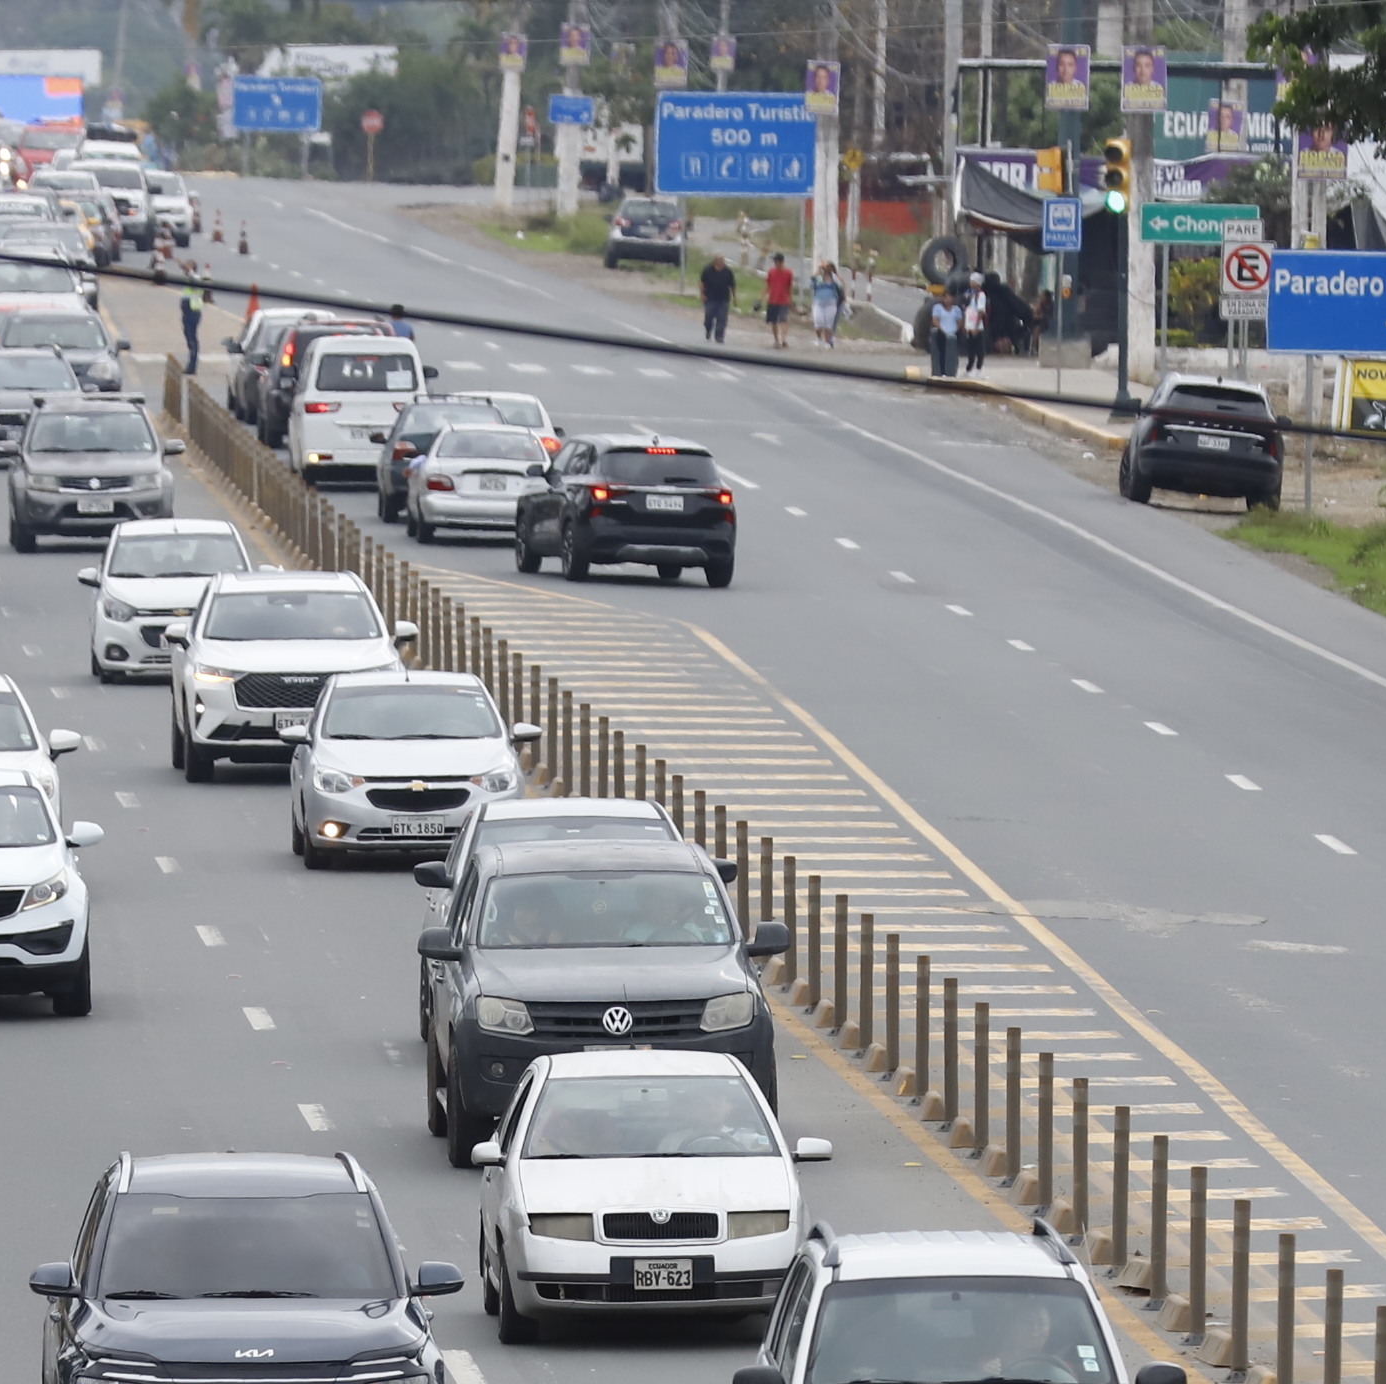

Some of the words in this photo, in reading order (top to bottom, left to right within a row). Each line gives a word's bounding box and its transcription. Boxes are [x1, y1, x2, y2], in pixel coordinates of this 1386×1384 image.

[663, 102, 744, 122] Paradero
[711, 128, 751, 146] 500
[760, 131, 778, 146] m
[1173, 215, 1224, 233] Chon
[1227, 224, 1259, 235] PARE
[1275, 269, 1384, 296] Paradero
[394, 823, 444, 834] GTK-1850
[635, 1270, 691, 1287] RBY-623
